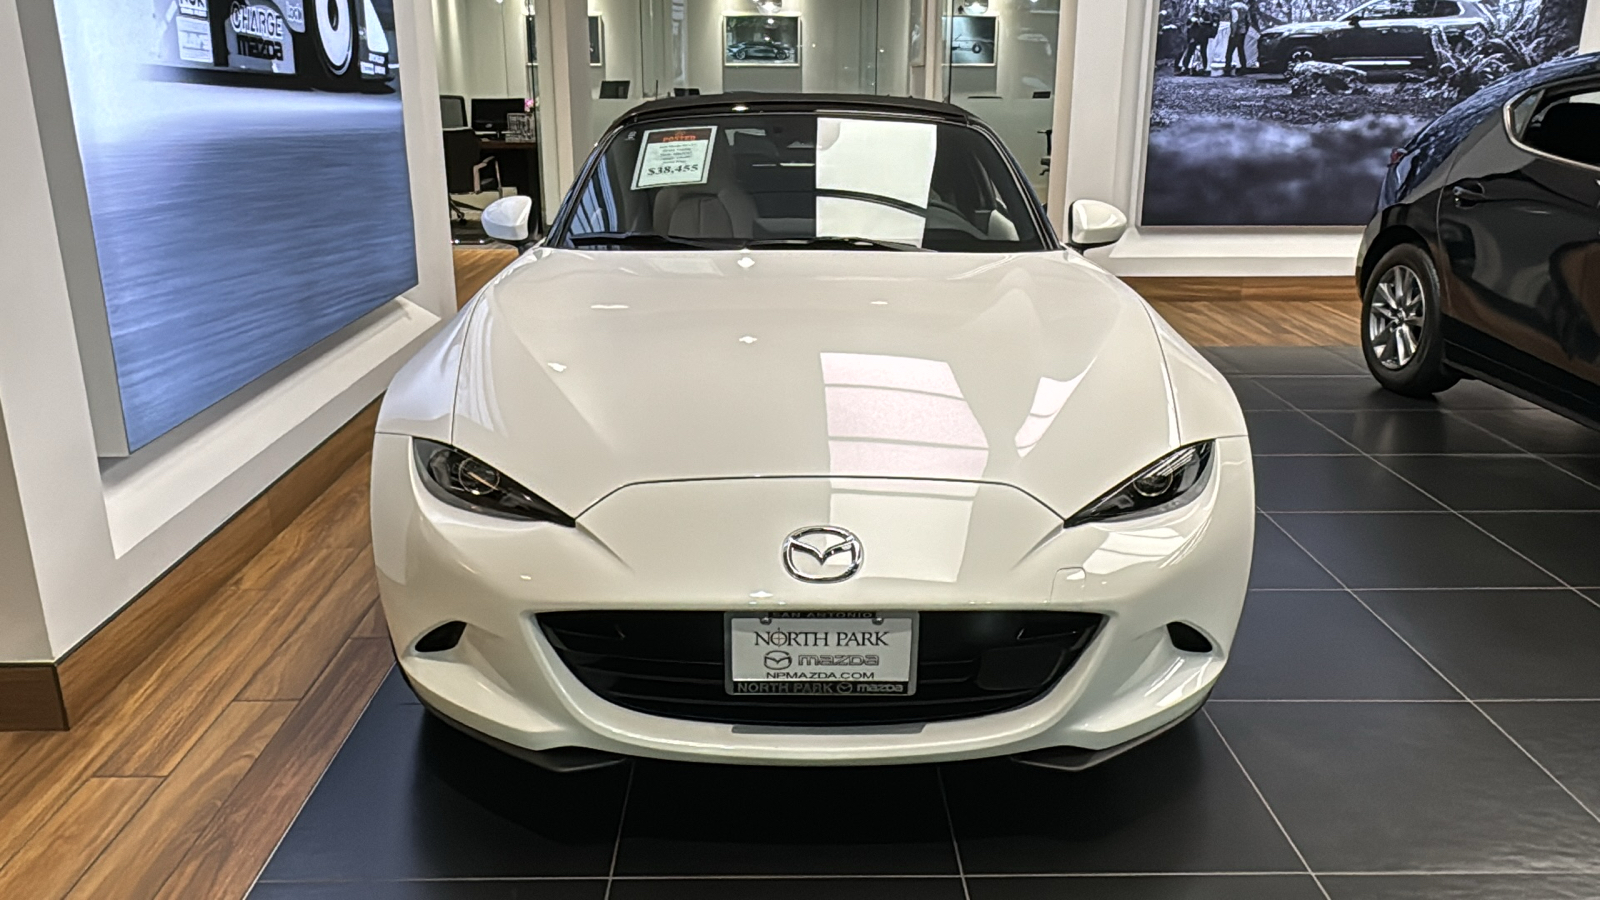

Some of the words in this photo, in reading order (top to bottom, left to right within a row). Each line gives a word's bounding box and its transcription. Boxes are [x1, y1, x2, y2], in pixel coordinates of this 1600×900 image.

[230, 1, 284, 39] CHARGE
[647, 164, 698, 176] $38,455
[753, 628, 829, 648] NORTH
[836, 631, 890, 647] PARK
[798, 654, 880, 667] mazda
[766, 671, 875, 680] NPMAZDA.COM
[737, 682, 789, 693] NORTH
[793, 682, 833, 693] PARK
[857, 683, 904, 693] mazda
